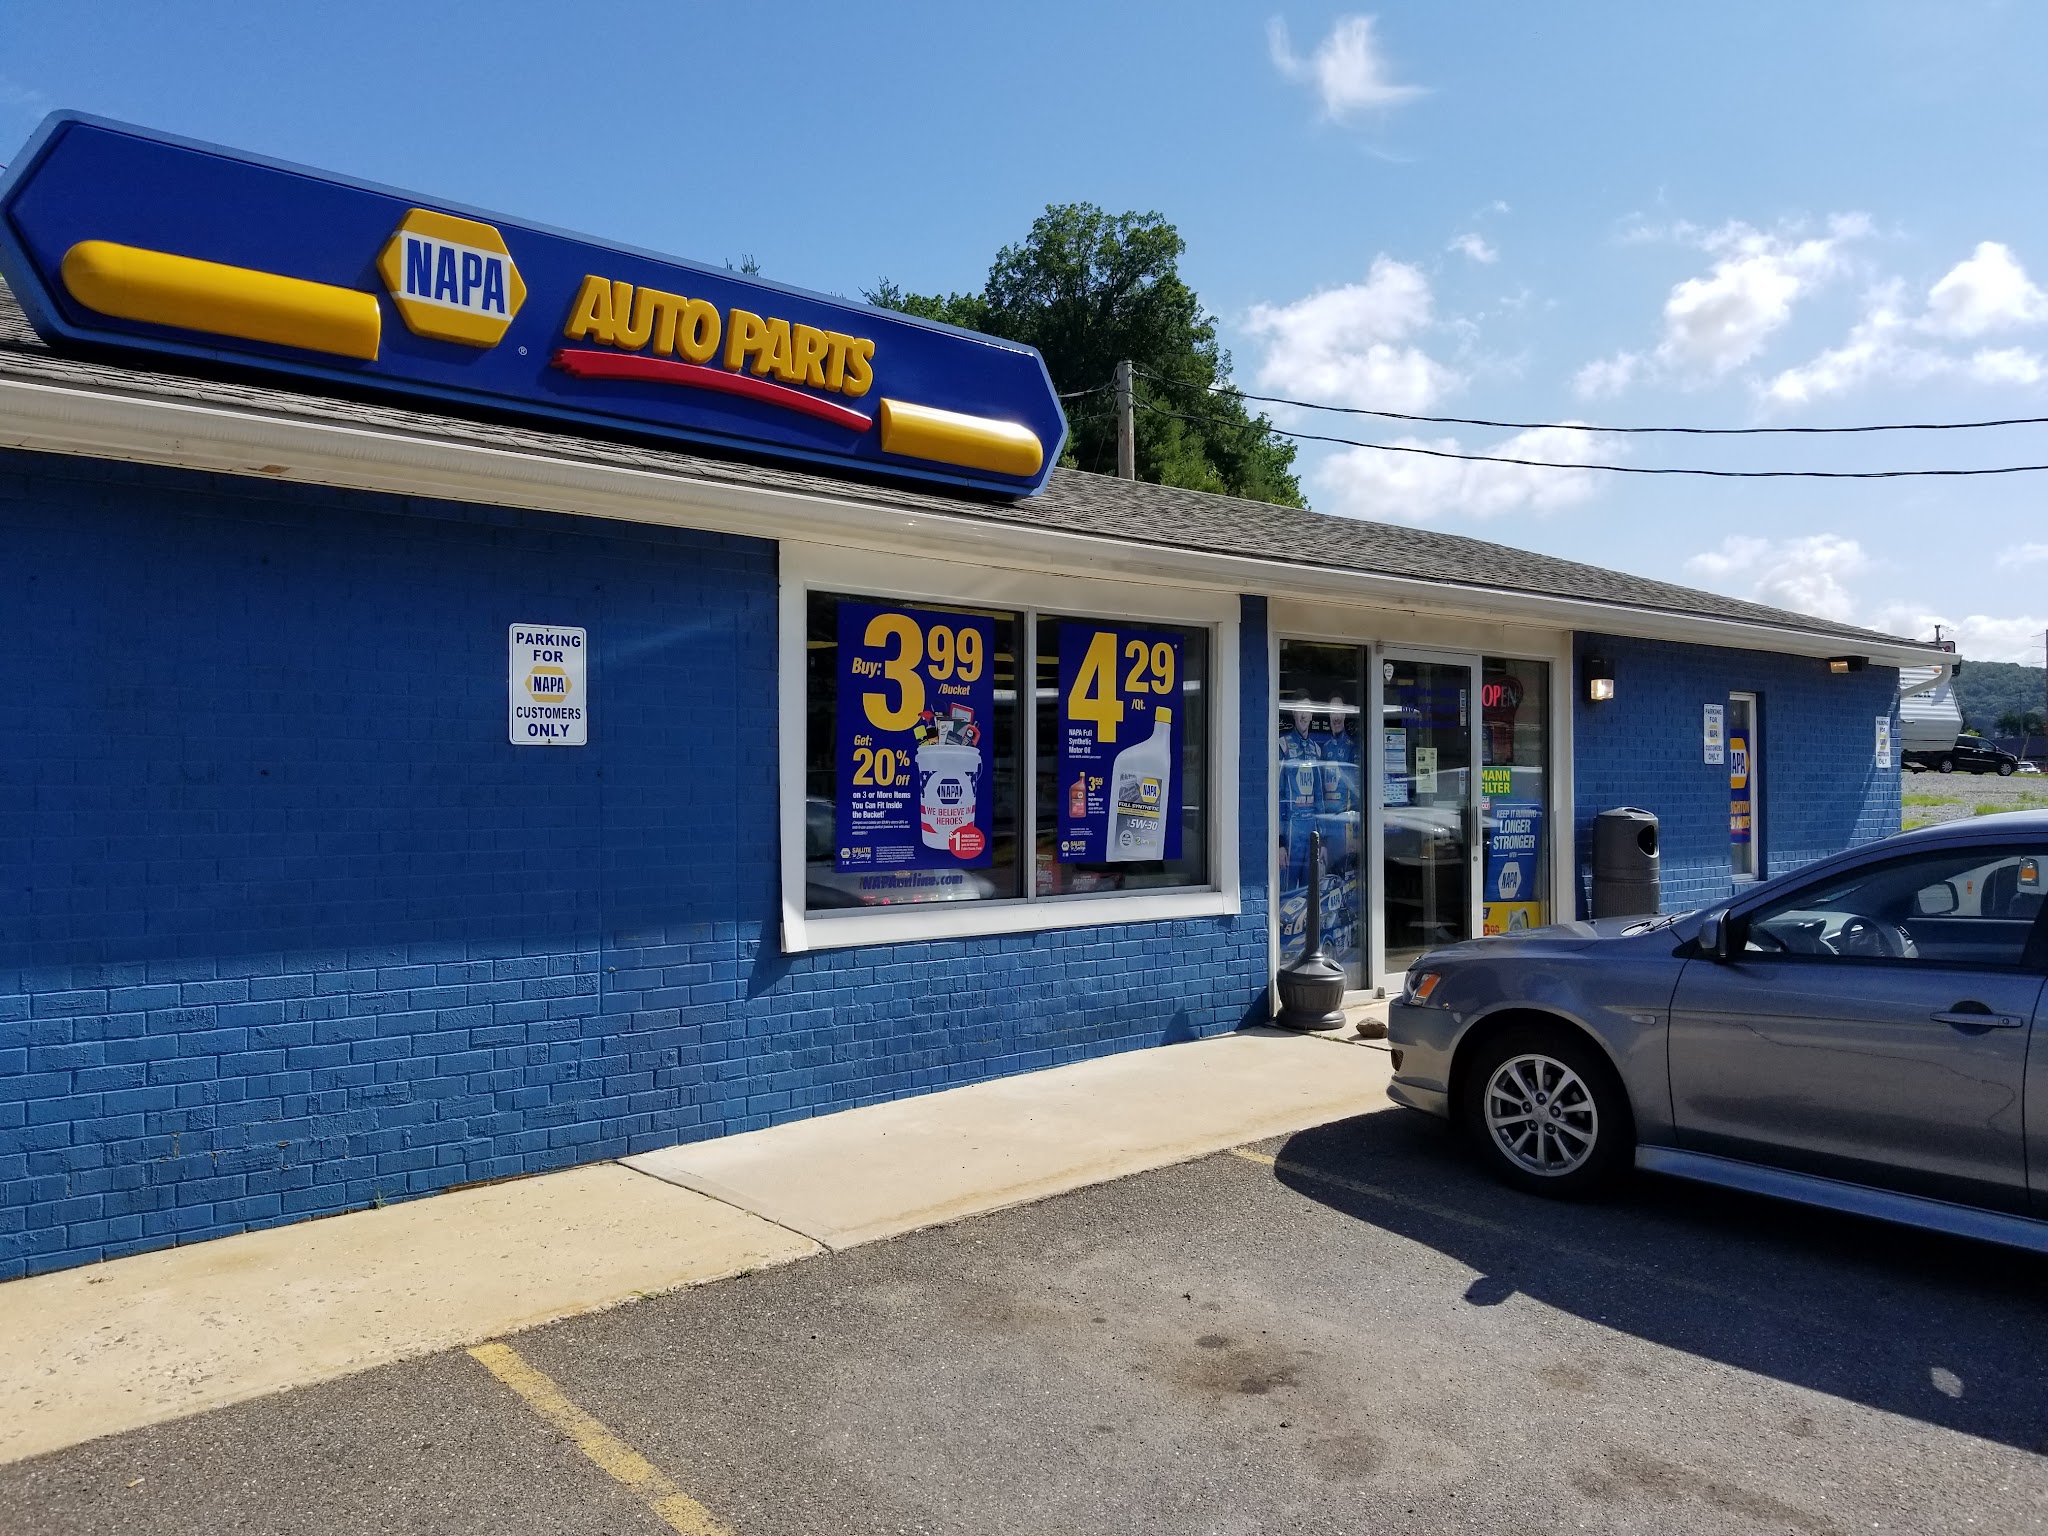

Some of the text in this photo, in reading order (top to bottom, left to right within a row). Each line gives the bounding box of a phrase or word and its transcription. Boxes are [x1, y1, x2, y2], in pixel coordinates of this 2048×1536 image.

[406, 237, 506, 315] NAPA
[563, 274, 876, 398] AUTO PARTS
[516, 632, 581, 648] PARKING
[533, 649, 564, 662] FOR
[852, 657, 882, 679] Buy:
[533, 676, 565, 693] NAPA
[1482, 684, 1517, 707] OPEN
[516, 706, 581, 720] CUSTOMERS
[527, 723, 570, 737] ONLY
[854, 735, 873, 747] Get:
[1731, 752, 1746, 774] APA
[862, 791, 867, 799] 3
[877, 791, 893, 799] More
[894, 791, 911, 799] Items
[941, 785, 961, 798] NAPA
[1142, 784, 1157, 797] NAPA
[852, 801, 903, 809] You Can Fit Inside
[926, 806, 937, 816] WE
[938, 808, 965, 817] BELIEVE
[1132, 803, 1160, 811] SYNTHETIC
[852, 811, 862, 819] the
[1496, 809, 1510, 818] KEEP
[1510, 809, 1516, 818] IT
[936, 816, 963, 826] HEROES
[1129, 818, 1158, 831] 5W-30
[1499, 819, 1531, 834] LONGER
[1493, 834, 1536, 851] STRONGER
[861, 872, 963, 890] NAPAonline.com
[1501, 871, 1518, 889] NAPA
